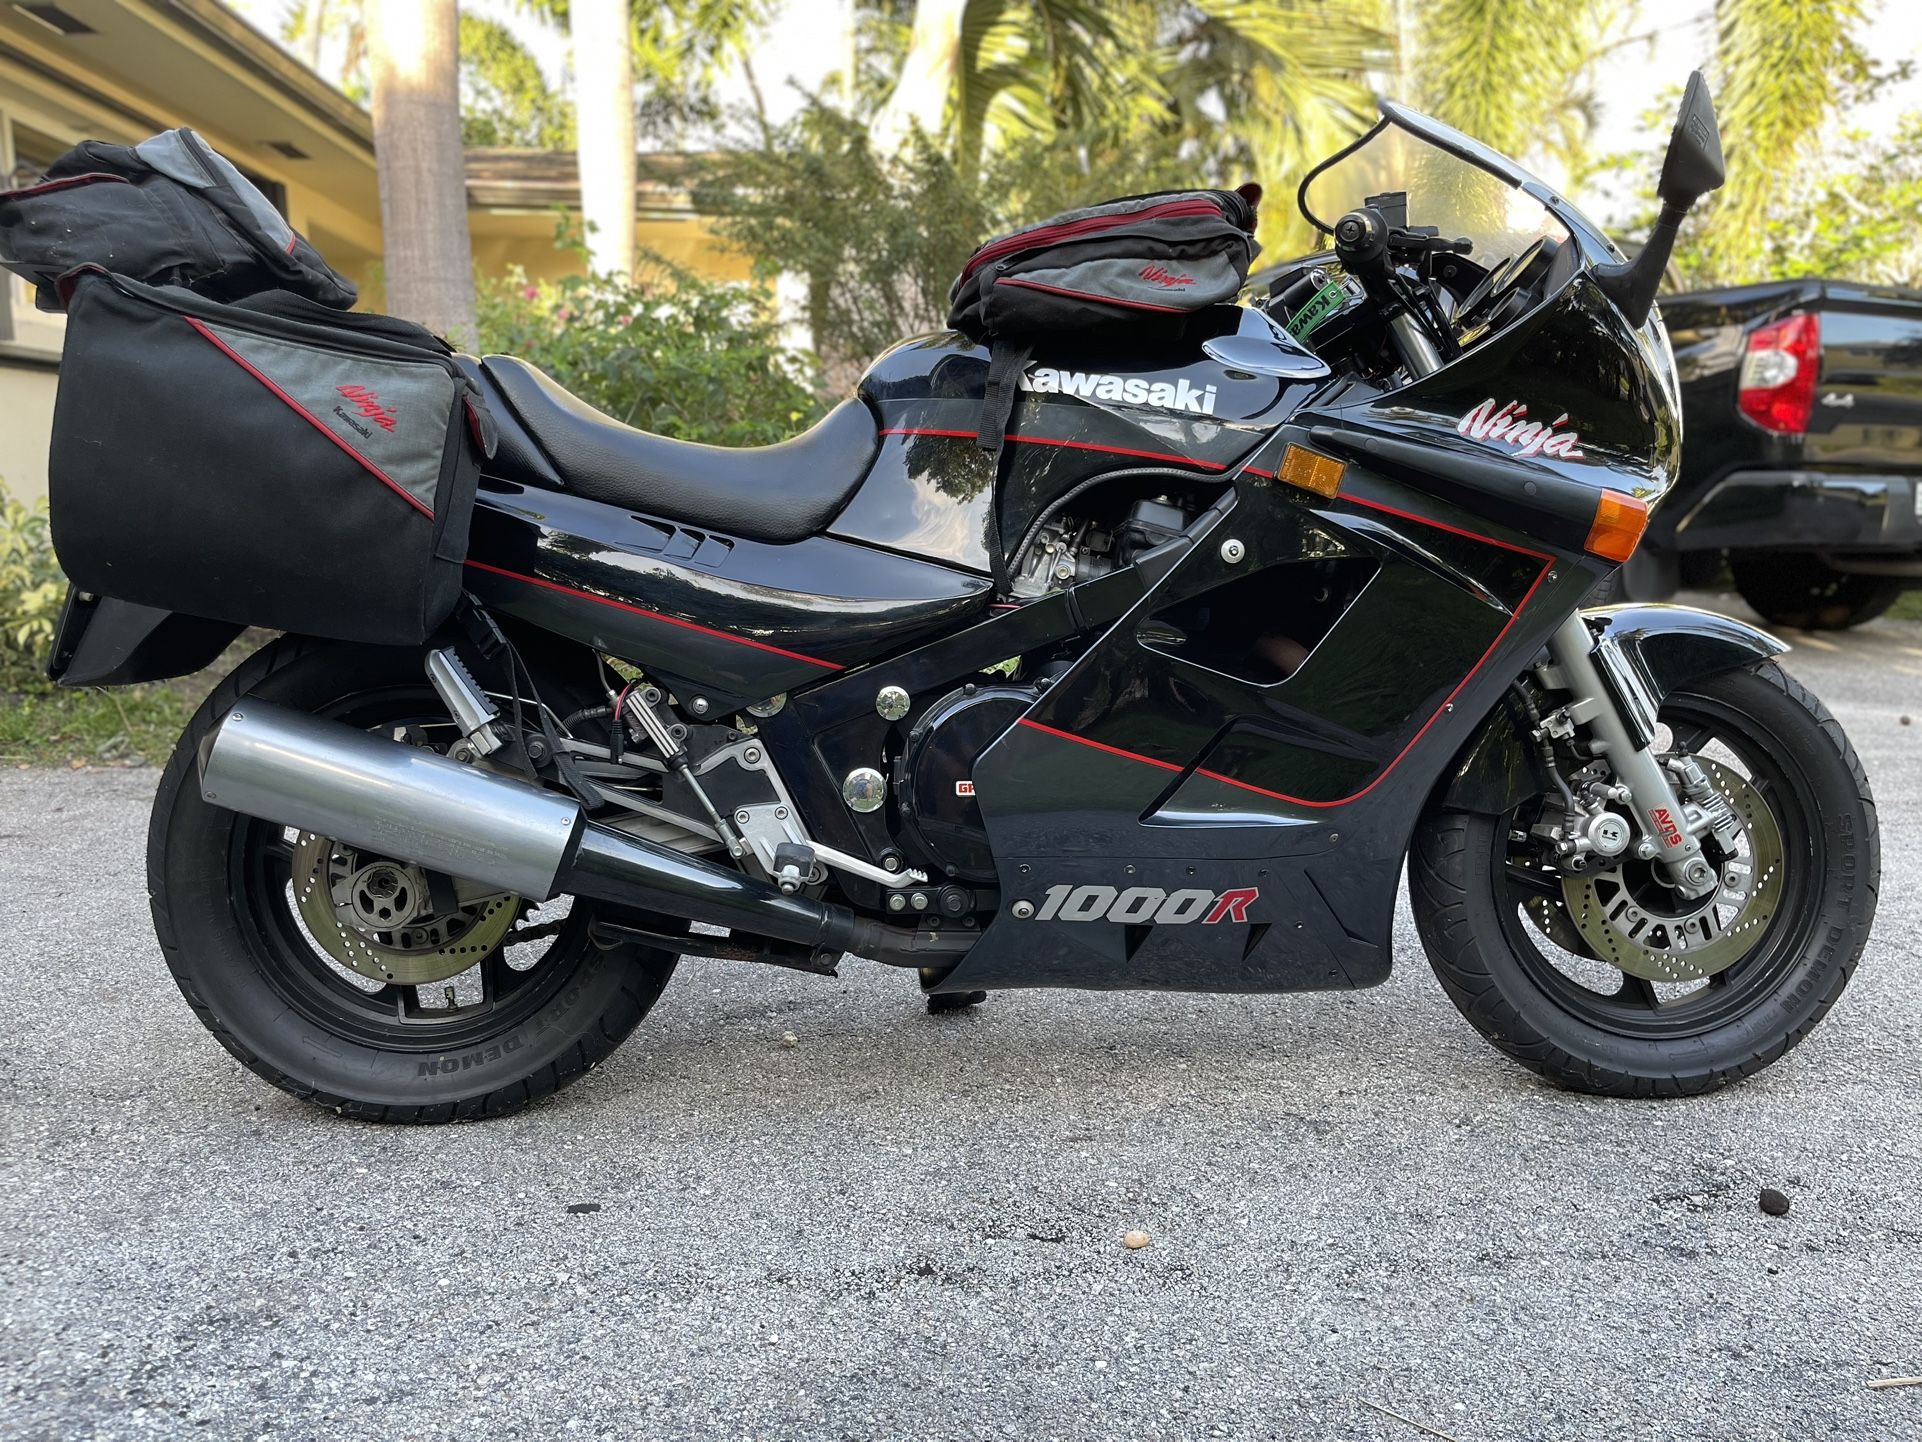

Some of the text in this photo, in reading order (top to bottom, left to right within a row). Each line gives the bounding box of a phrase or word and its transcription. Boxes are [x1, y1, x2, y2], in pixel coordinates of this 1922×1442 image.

[1288, 294, 1331, 338] Kawa
[336, 384, 397, 433] Ninja
[1457, 397, 1585, 460] Ninja
[1035, 884, 1259, 924] 1000R
[1780, 926, 1842, 1014] DEMON
[417, 1037, 523, 1077] DEMON
